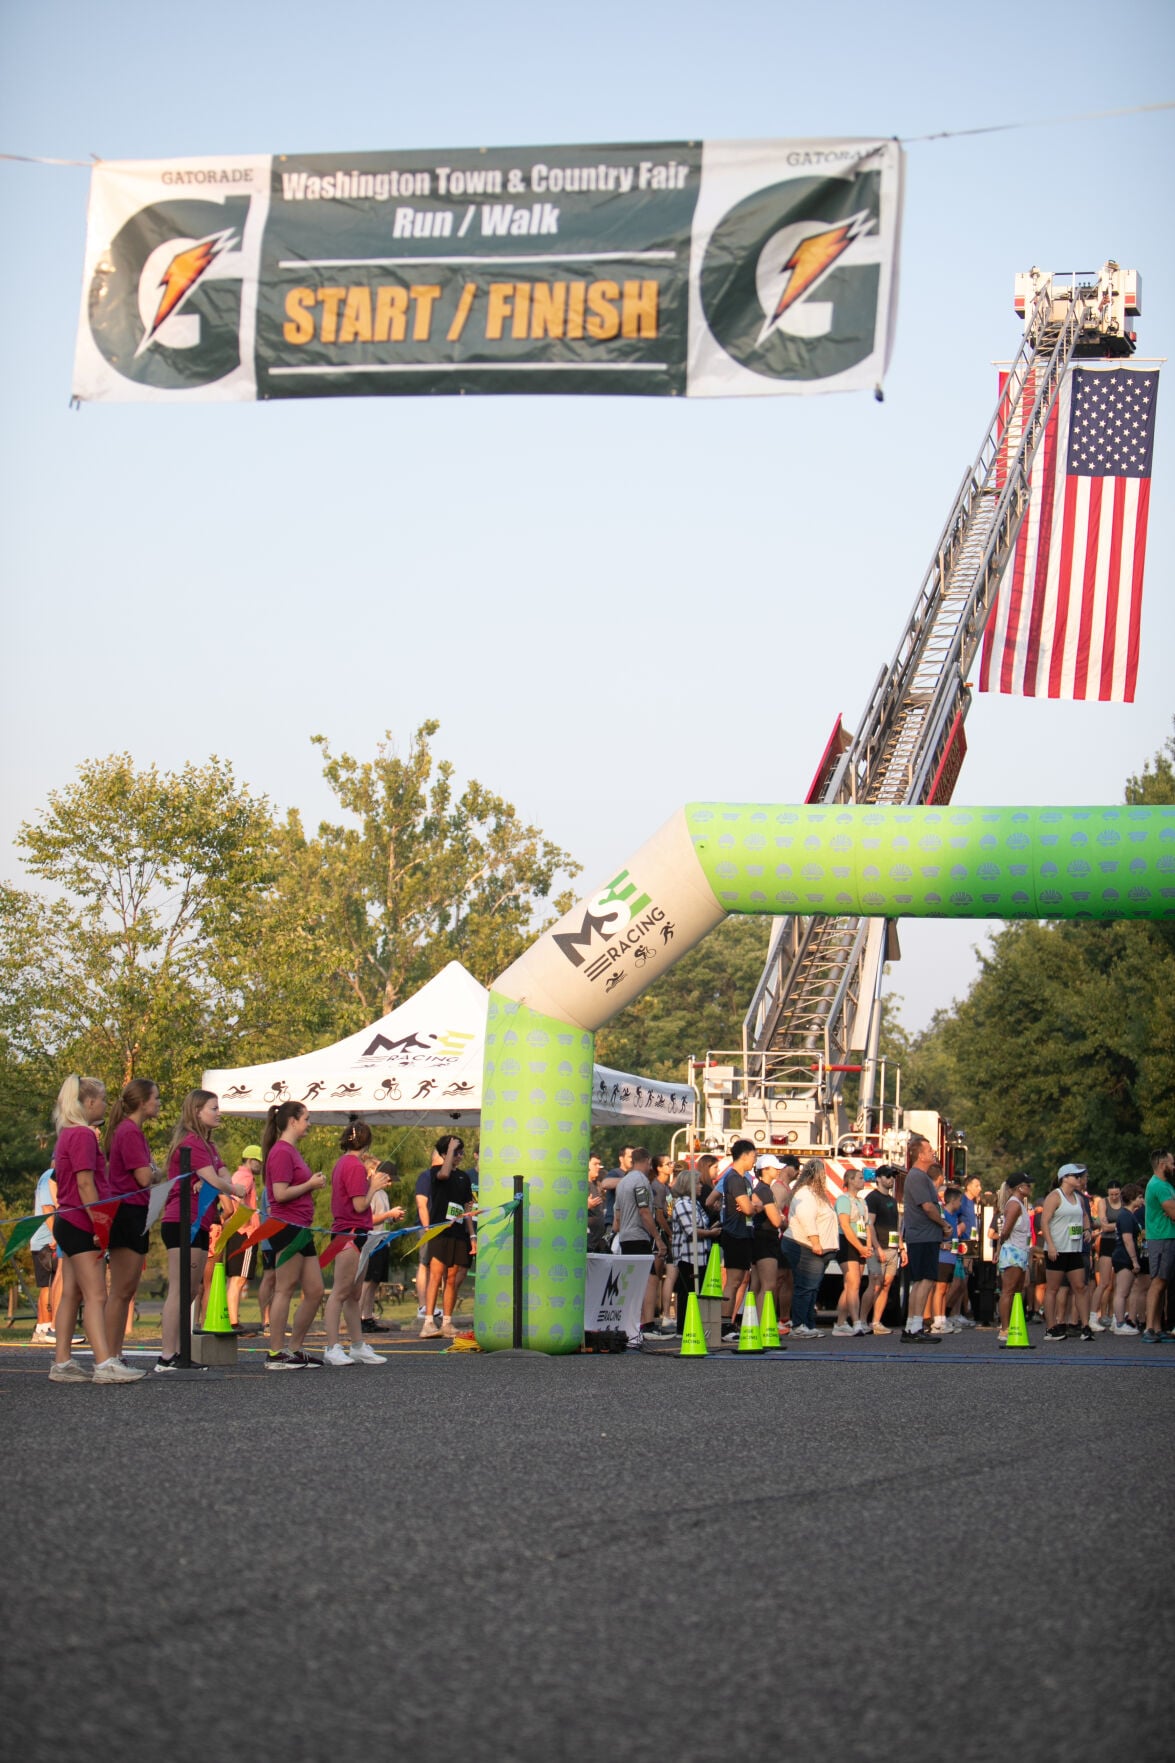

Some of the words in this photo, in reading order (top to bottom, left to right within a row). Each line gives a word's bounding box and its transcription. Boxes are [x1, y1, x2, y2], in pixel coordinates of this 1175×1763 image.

[161, 168, 255, 186] GATORADE
[283, 170, 430, 201] Washington
[435, 166, 502, 196] Town
[506, 168, 526, 194] &
[531, 163, 632, 197] Country
[638, 161, 690, 190] Fair
[393, 206, 453, 239] Run
[457, 205, 474, 238] /
[480, 203, 560, 236] Walk
[283, 283, 442, 346] START
[445, 282, 477, 343] /
[485, 279, 660, 342] FINISH
[606, 906, 666, 962] RACING
[386, 1054, 460, 1063] RACING
